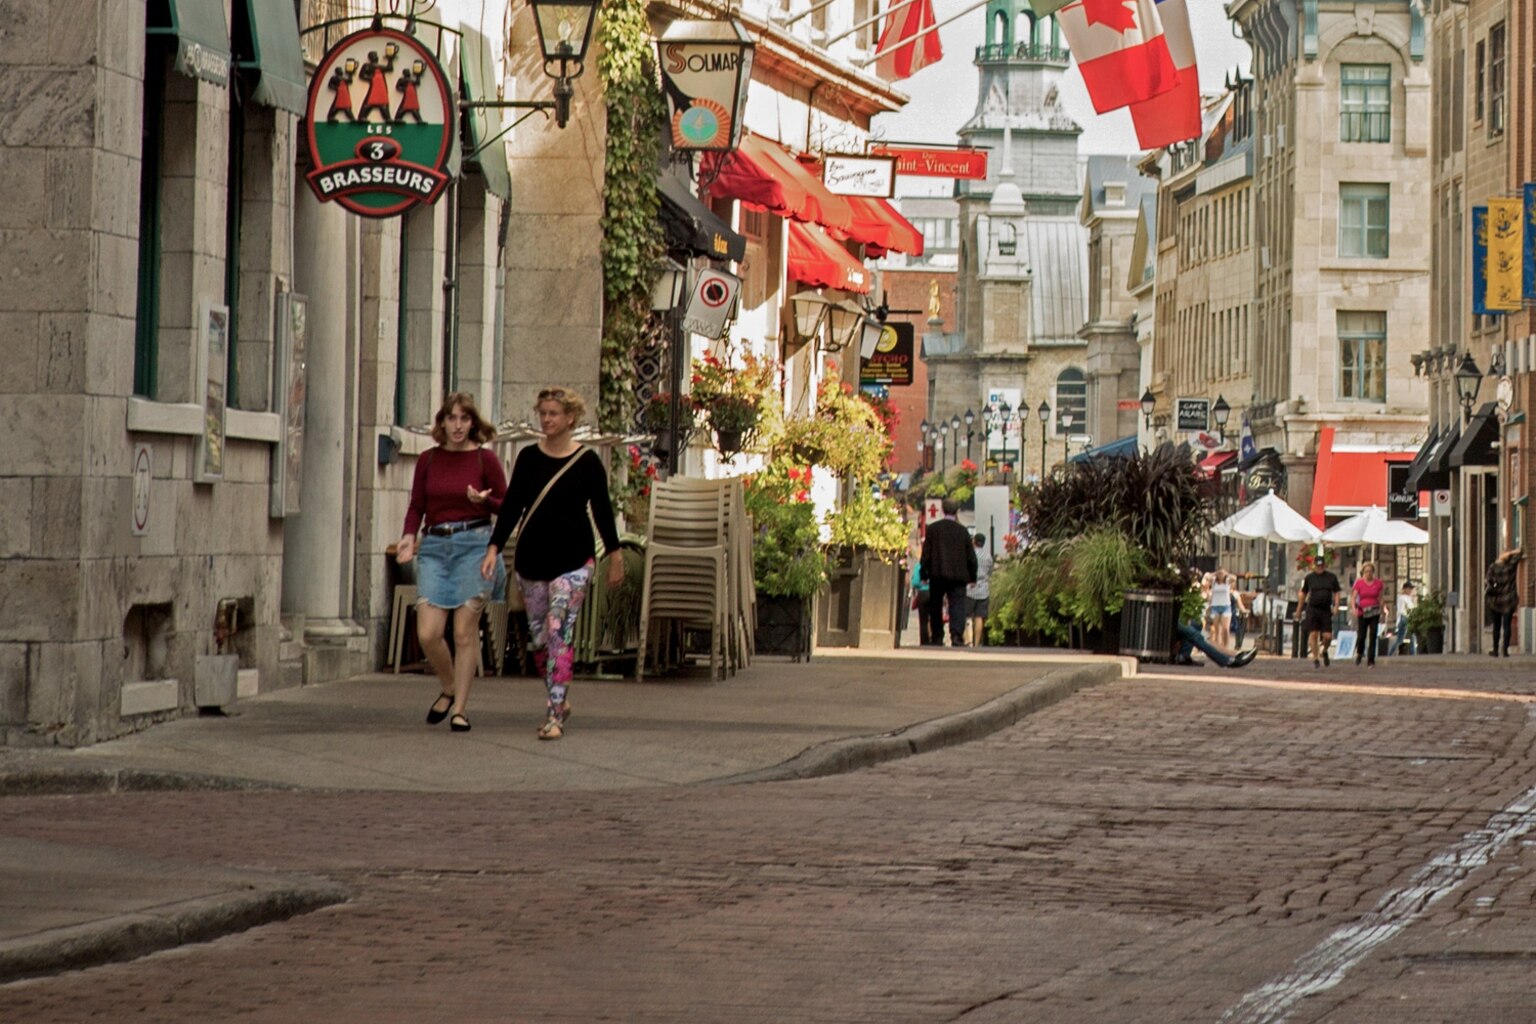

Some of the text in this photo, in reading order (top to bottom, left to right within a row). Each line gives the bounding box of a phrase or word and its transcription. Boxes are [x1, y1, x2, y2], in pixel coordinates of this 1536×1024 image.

[367, 125, 392, 134] LES
[370, 142, 385, 160] 3
[897, 160, 970, 174] aint-Vincent
[319, 166, 435, 194] BRASSEURS
